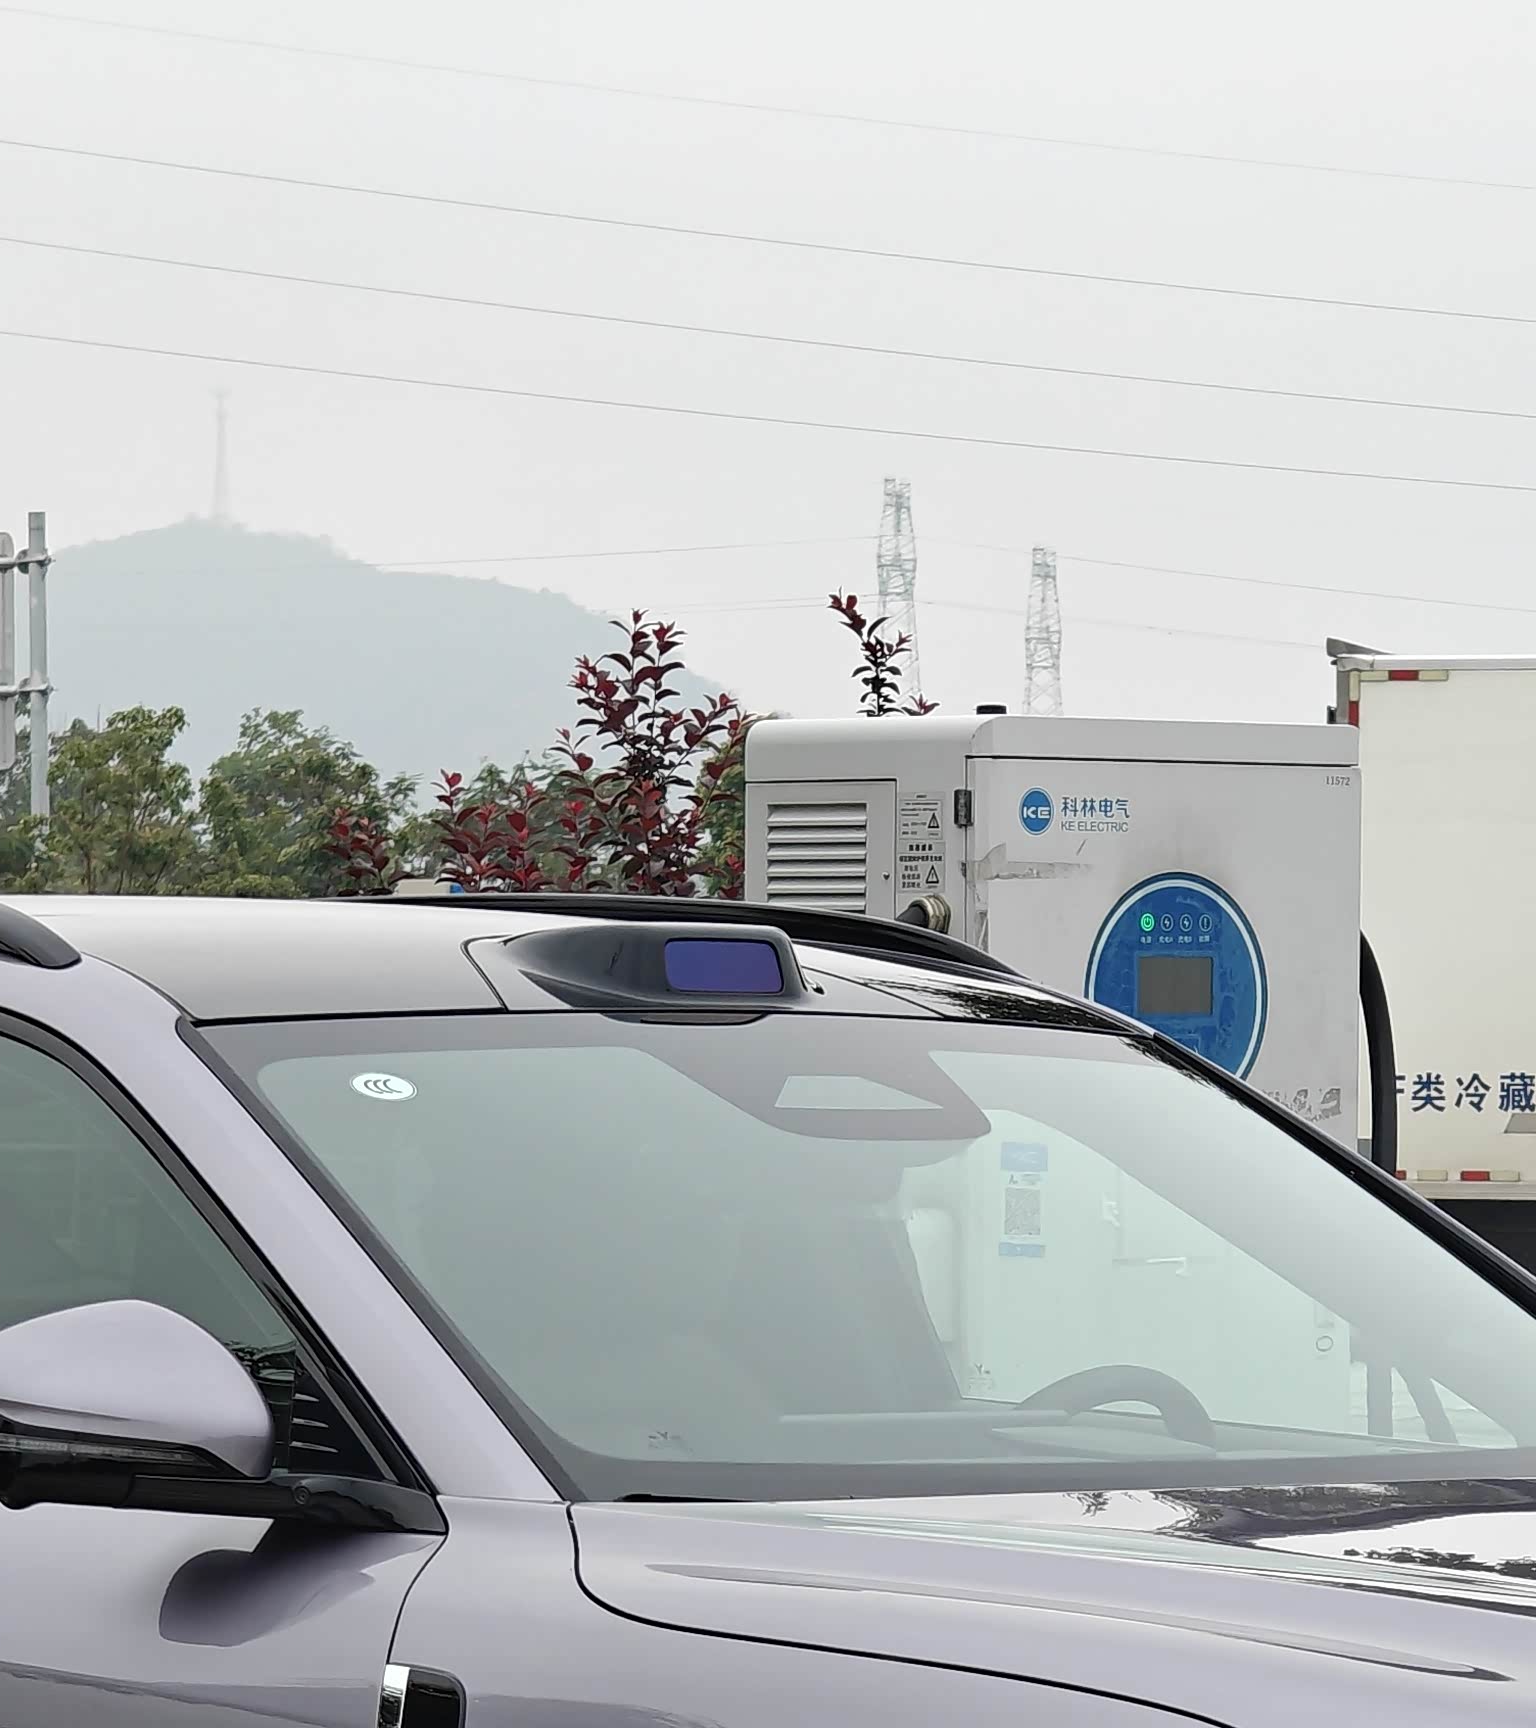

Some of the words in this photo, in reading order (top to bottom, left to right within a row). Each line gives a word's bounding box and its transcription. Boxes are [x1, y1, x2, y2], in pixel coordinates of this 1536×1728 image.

[1326, 776, 1351, 786] 11572
[1023, 806, 1051, 819] KE
[1061, 796, 1131, 819] 科林电气
[1061, 821, 1076, 832] KE
[1078, 821, 1129, 833] ELECTRIC
